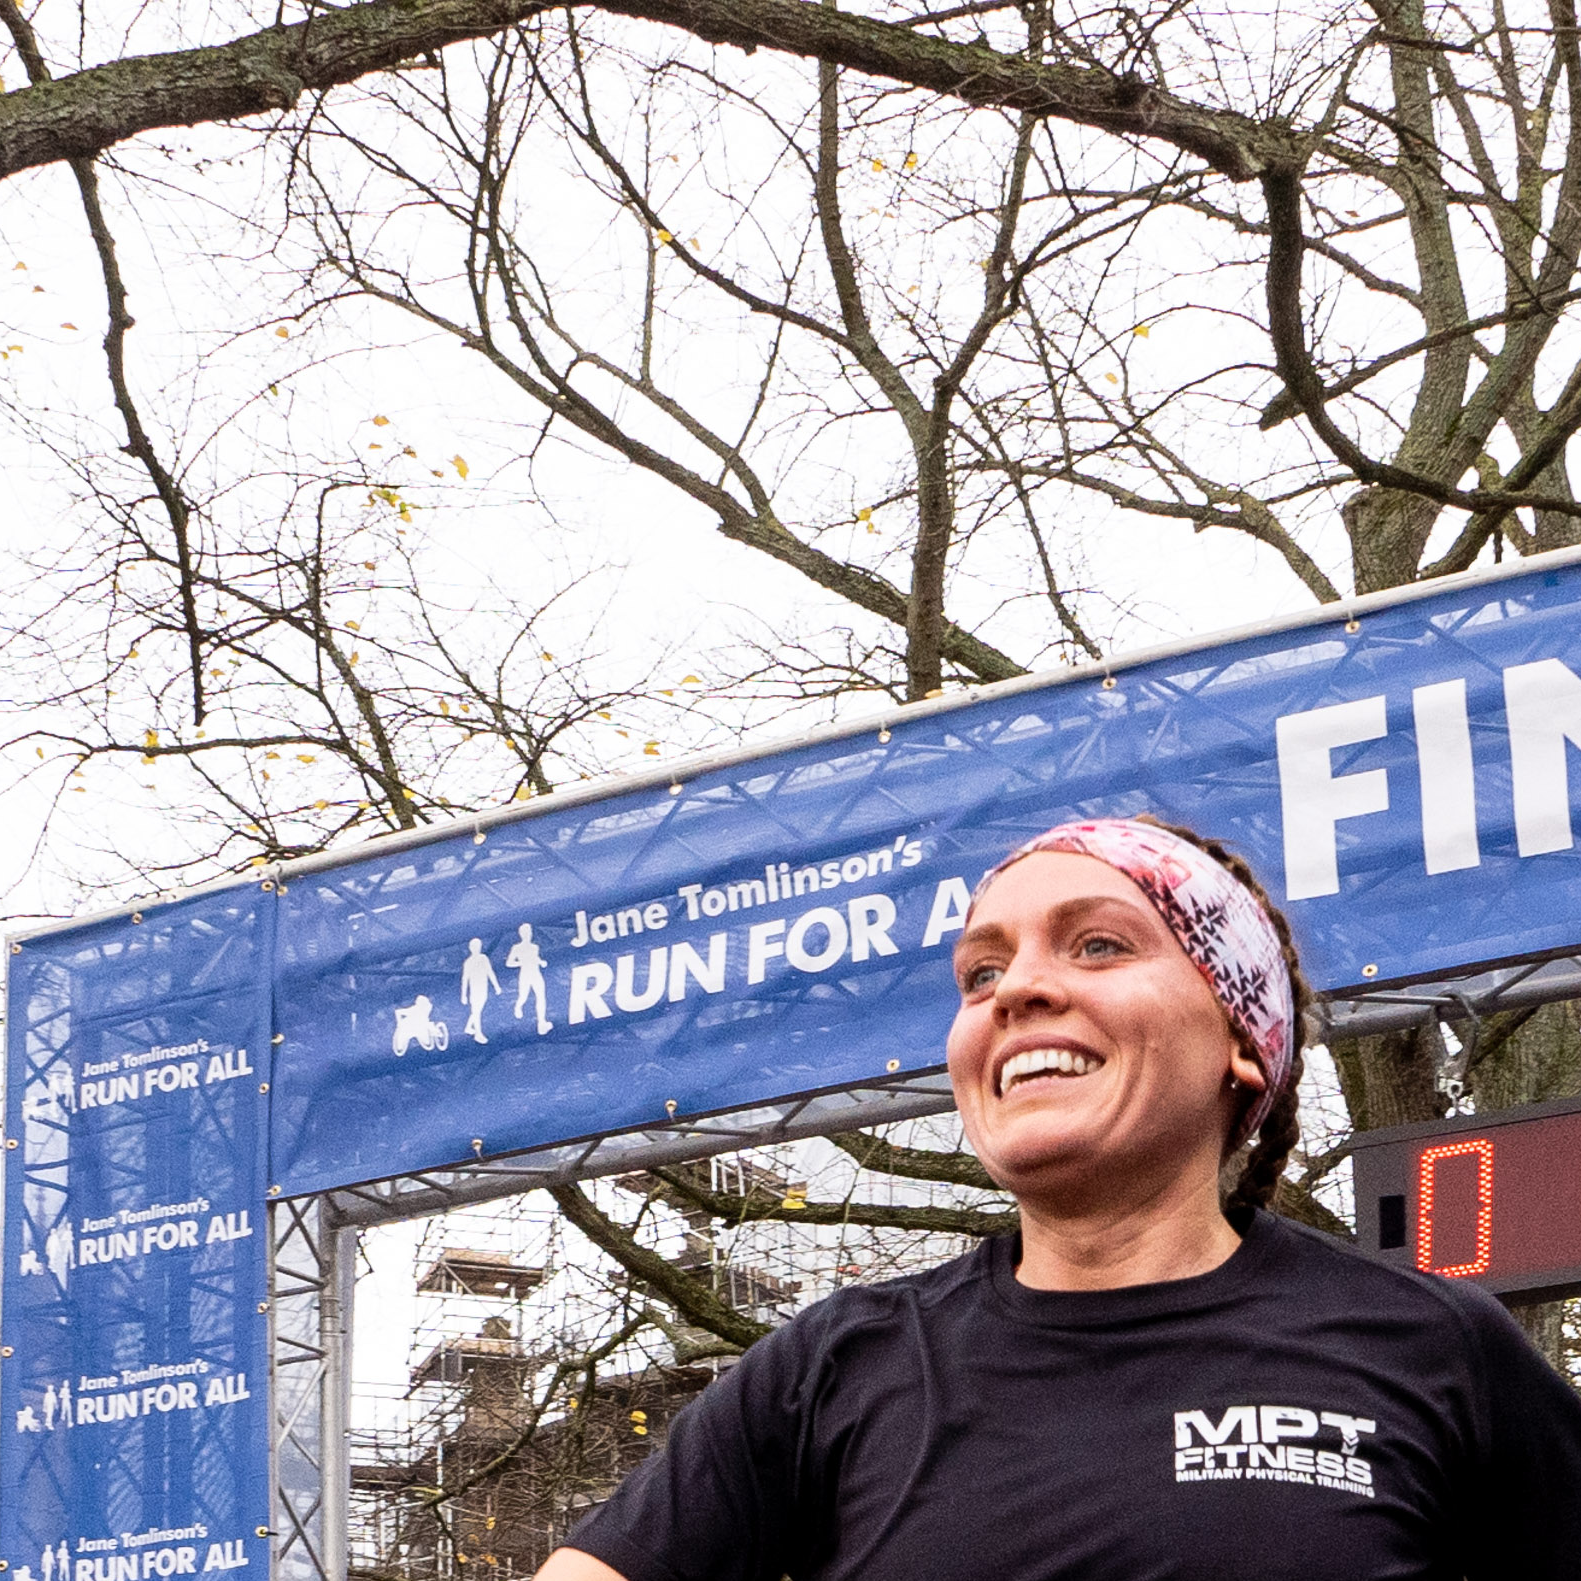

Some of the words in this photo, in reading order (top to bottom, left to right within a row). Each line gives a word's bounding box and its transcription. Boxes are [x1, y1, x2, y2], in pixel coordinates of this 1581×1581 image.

[570, 901, 668, 949] Jane
[678, 835, 923, 922] Tomlinson's
[568, 933, 727, 1025] RUN
[747, 893, 897, 985] FOR
[82, 1056, 119, 1078] Jane
[124, 1039, 208, 1069] Tomlinson's
[80, 1076, 137, 1110] RUN
[144, 1063, 200, 1096] FOR
[205, 1050, 253, 1083] ALL
[80, 1213, 115, 1233] Jane
[119, 1198, 209, 1226] Tomlinson's
[80, 1233, 136, 1266] RUN
[143, 1221, 198, 1255] FOR
[205, 1211, 253, 1244] ALL
[78, 1375, 117, 1392] Jane
[121, 1358, 208, 1386] Tomlinson's
[77, 1391, 137, 1425] RUN
[143, 1382, 198, 1414] FOR
[205, 1373, 250, 1407] ALL
[1174, 1405, 1376, 1455] MPT
[1175, 1445, 1373, 1484] FITNESS
[1176, 1468, 1243, 1482] MILITARY
[1246, 1470, 1314, 1485] PHYSICAL
[1316, 1475, 1374, 1498] TRAINING
[76, 1538, 117, 1553] Jane
[121, 1523, 207, 1548] Tomlinson's
[143, 1546, 196, 1579] FOR
[204, 1540, 248, 1572] ALL
